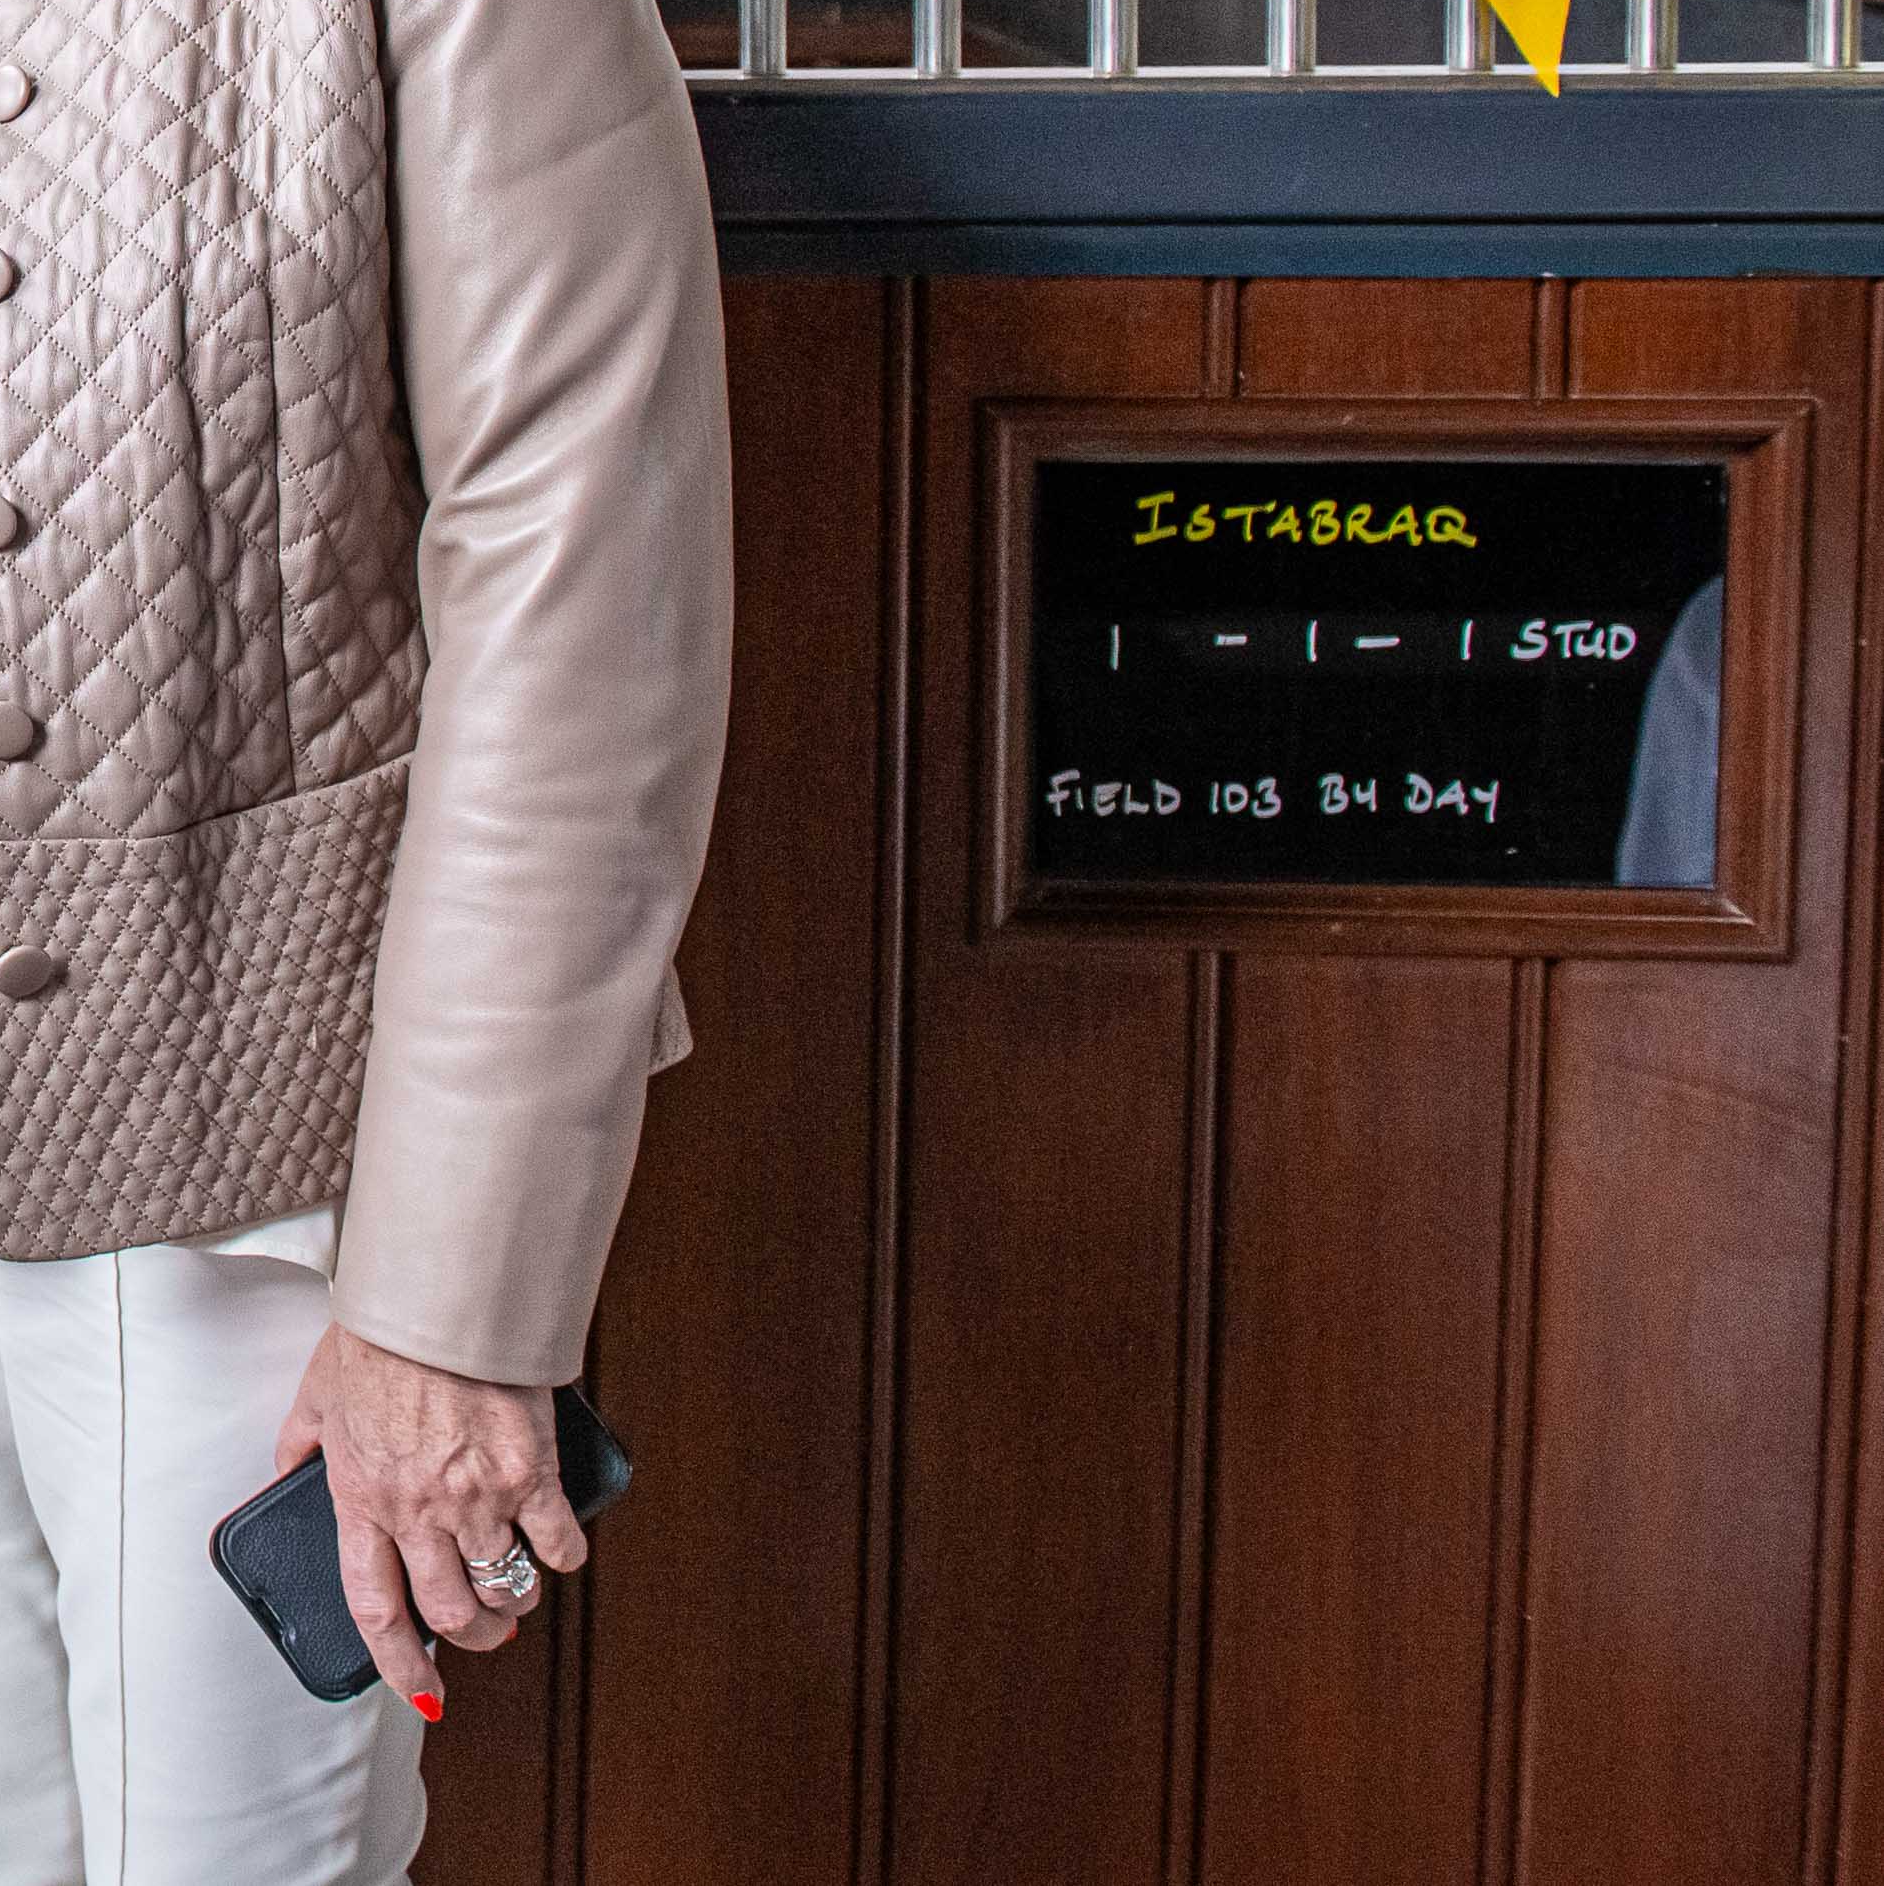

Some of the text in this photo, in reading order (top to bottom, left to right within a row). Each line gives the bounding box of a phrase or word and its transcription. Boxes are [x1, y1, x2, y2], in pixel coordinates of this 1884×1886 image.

[1133, 490, 1477, 547] ISTABRAQ
[1509, 619, 1637, 661] STUD
[1047, 769, 1181, 817] FIELD
[1210, 776, 1282, 818] 103
[1403, 773, 1500, 824] DAY
